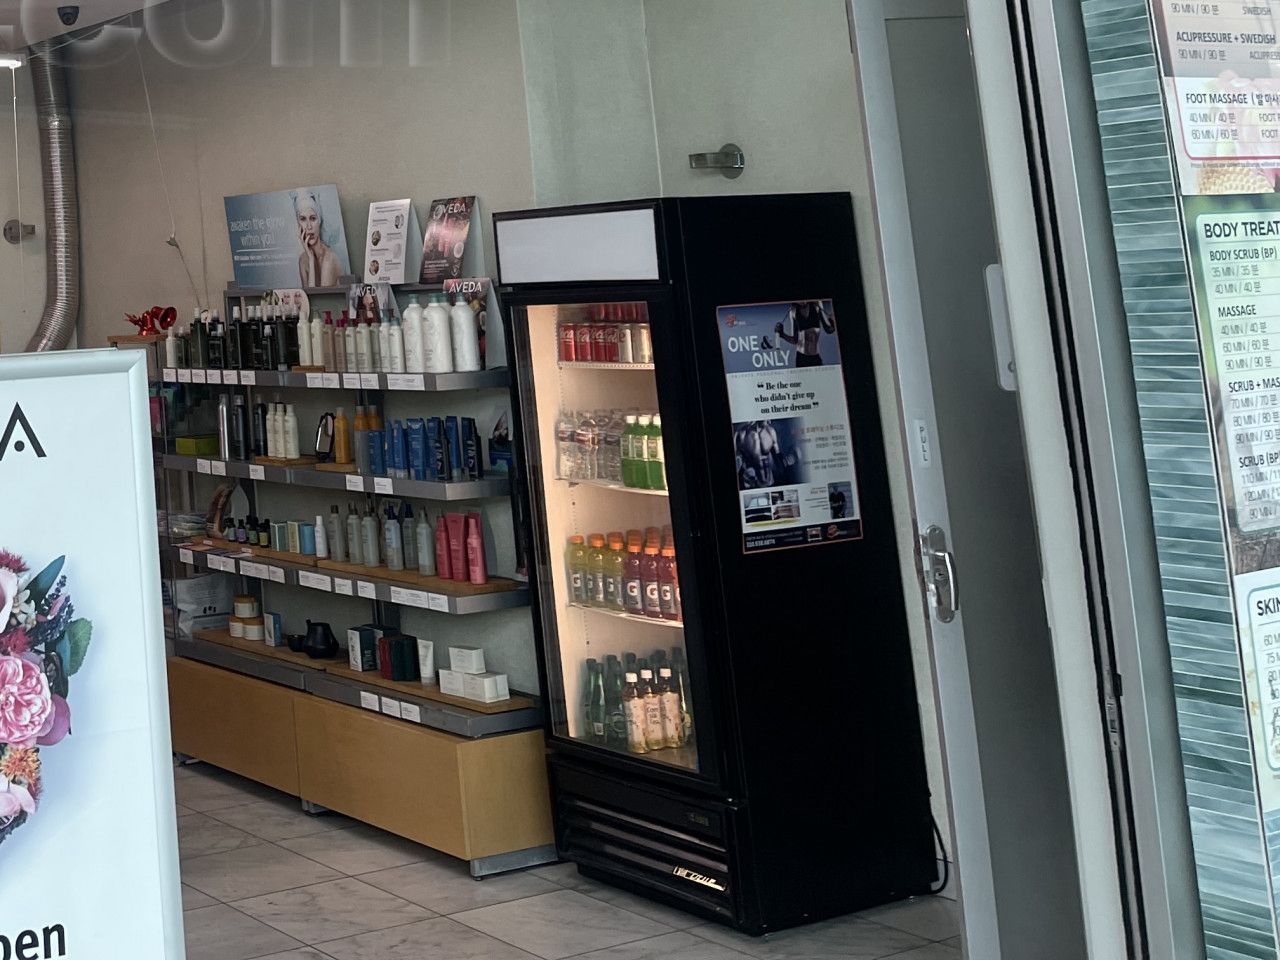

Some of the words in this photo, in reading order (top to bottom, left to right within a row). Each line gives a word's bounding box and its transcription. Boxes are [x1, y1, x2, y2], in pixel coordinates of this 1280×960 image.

[1177, 31, 1232, 43] ACUPRESSURE
[1240, 33, 1276, 44] SWEDISH
[1186, 94, 1207, 104] FOOT
[1209, 94, 1248, 104] MASSAGE
[1204, 222, 1238, 238] BODY
[1241, 221, 1280, 236] TREAT
[1210, 250, 1231, 261] BODY
[1234, 249, 1259, 259] SCRUB
[1261, 246, 1277, 260] (BP)
[448, 281, 482, 293] AVEDA
[1218, 305, 1256, 317] MASSAGE
[728, 336, 759, 352] ONE
[752, 350, 790, 368] ONLY
[1229, 380, 1254, 392] SCRUB
[771, 405, 789, 413] their
[919, 425, 929, 462] PULL
[1239, 455, 1265, 468] SCRUB
[627, 582, 637, 596] G
[647, 584, 658, 599] G
[661, 586, 671, 600] G
